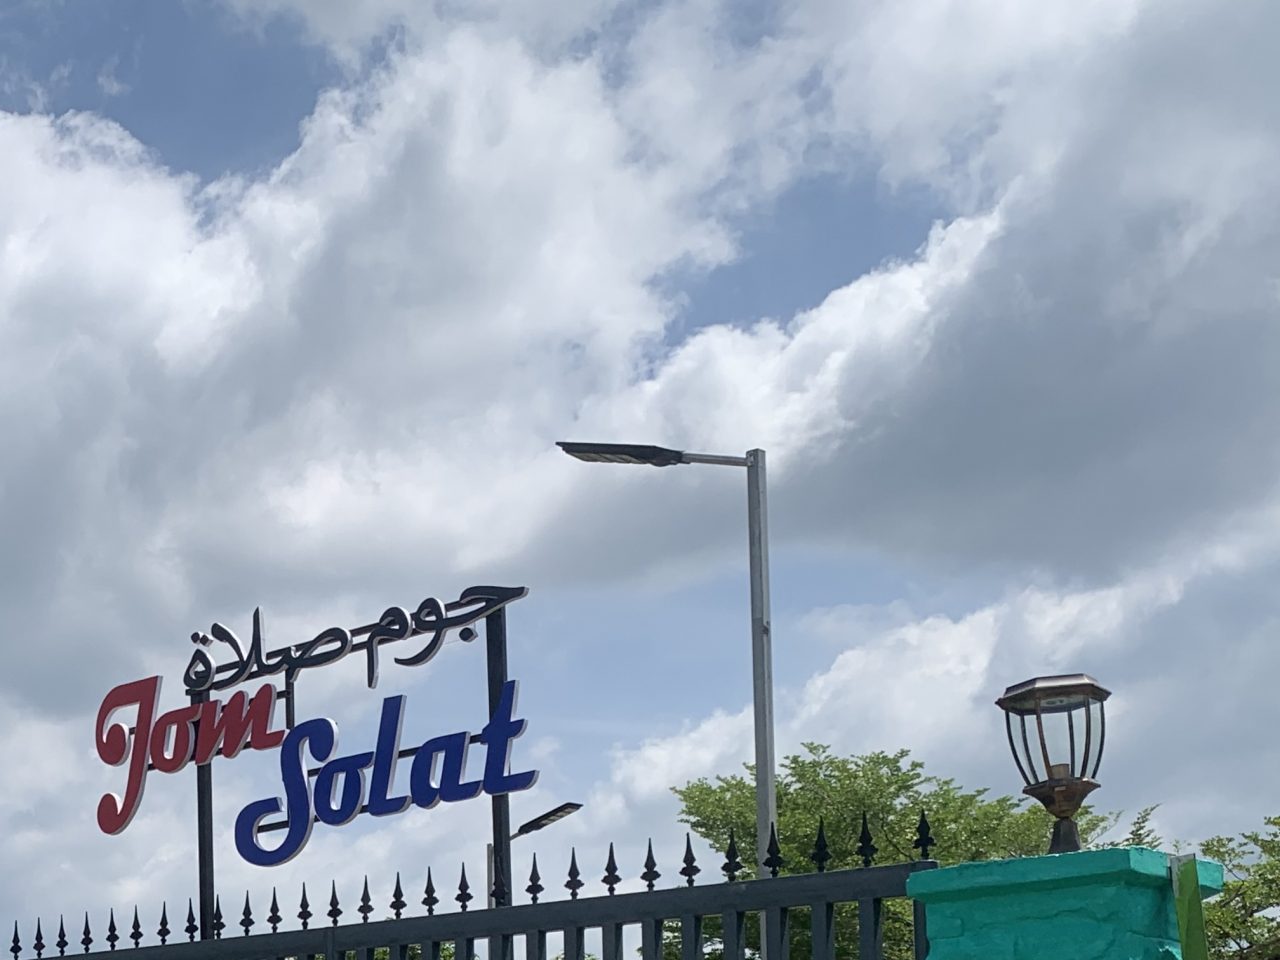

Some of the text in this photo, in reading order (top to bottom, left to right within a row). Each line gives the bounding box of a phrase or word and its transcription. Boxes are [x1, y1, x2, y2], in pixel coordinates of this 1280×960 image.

[183, 585, 529, 691] جوم صلاة
[95, 674, 288, 836] Jom
[234, 679, 540, 867] Solat
